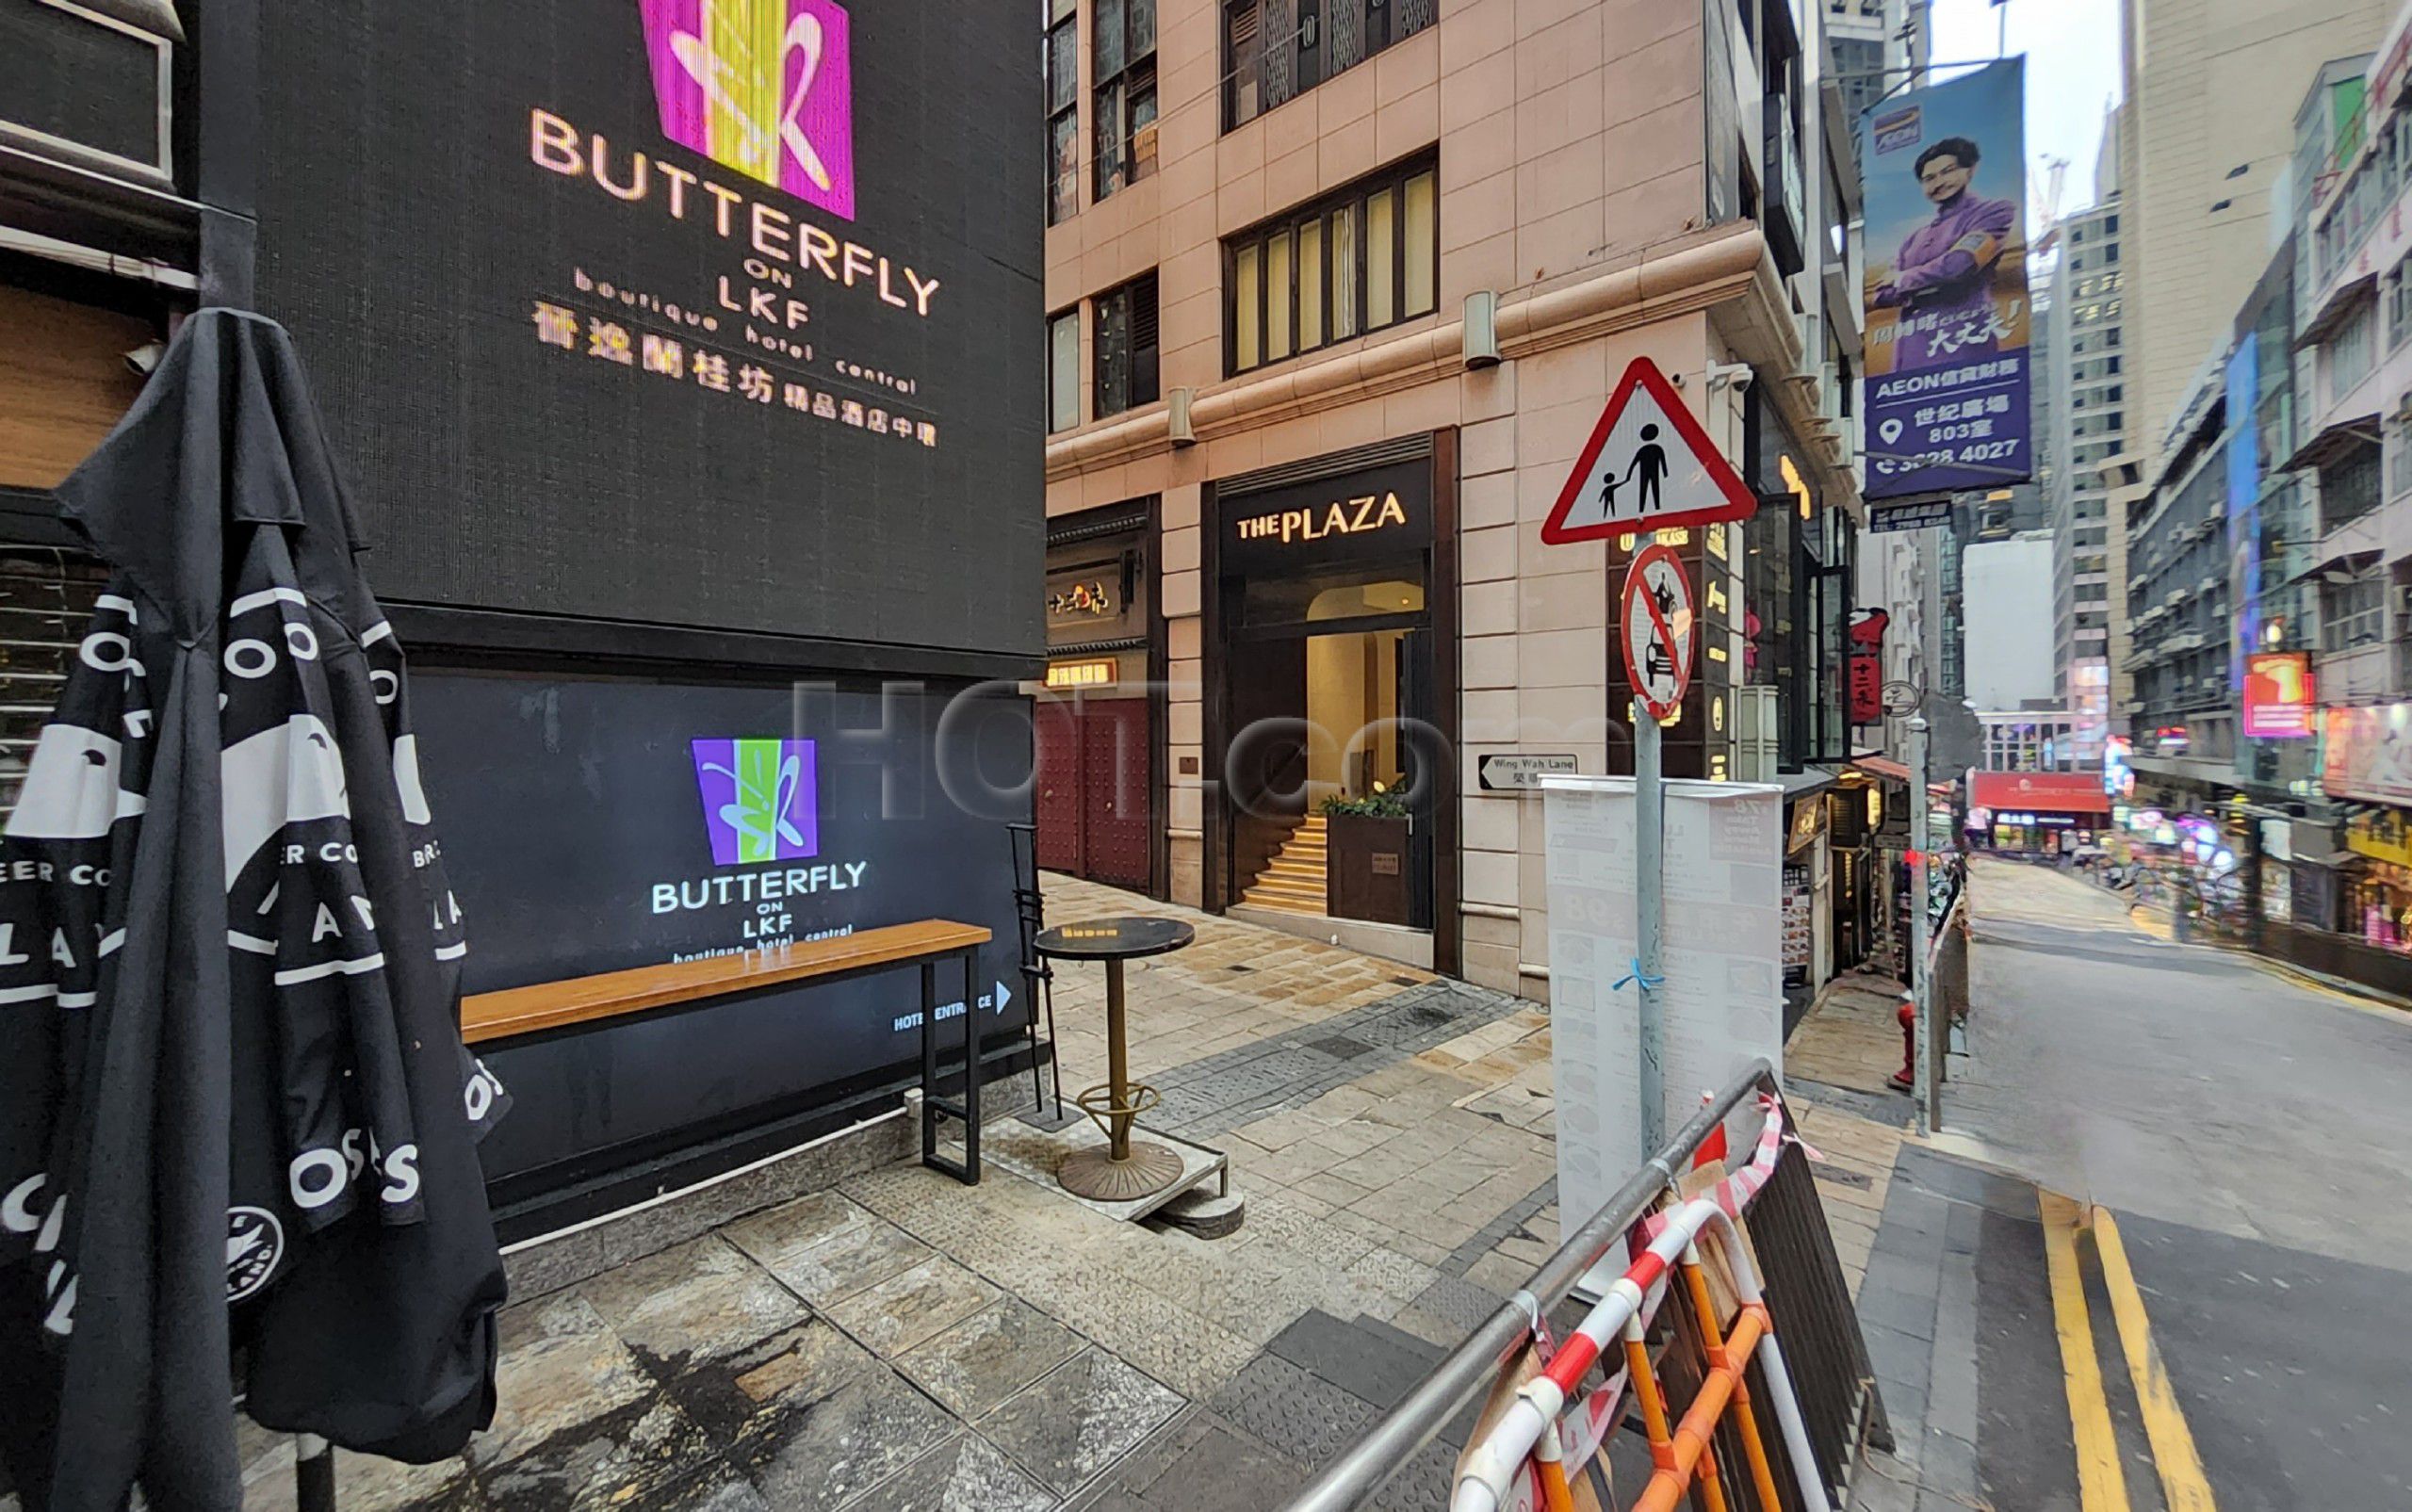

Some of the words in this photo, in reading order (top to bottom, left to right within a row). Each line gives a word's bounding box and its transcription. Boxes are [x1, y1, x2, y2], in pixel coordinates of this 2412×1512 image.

[530, 107, 939, 317] BUTTERFLY
[743, 258, 792, 289] ON
[718, 275, 809, 330] LKF
[574, 266, 718, 331] boutique
[745, 323, 813, 362] hotel
[835, 359, 916, 396] central
[1959, 438, 2020, 463] 4027
[1237, 514, 1279, 540] THE
[1282, 492, 1406, 544] PLAZA
[1493, 758, 1518, 770] Wing
[1522, 758, 1545, 769] Wah
[1548, 758, 1574, 770] Lane
[652, 860, 867, 914] BUTTERFLY
[757, 902, 783, 915] ON
[743, 914, 792, 938] LKF
[805, 924, 853, 942] central
[894, 1012, 923, 1032] HOTE
[934, 995, 992, 1020] ENTRCE
